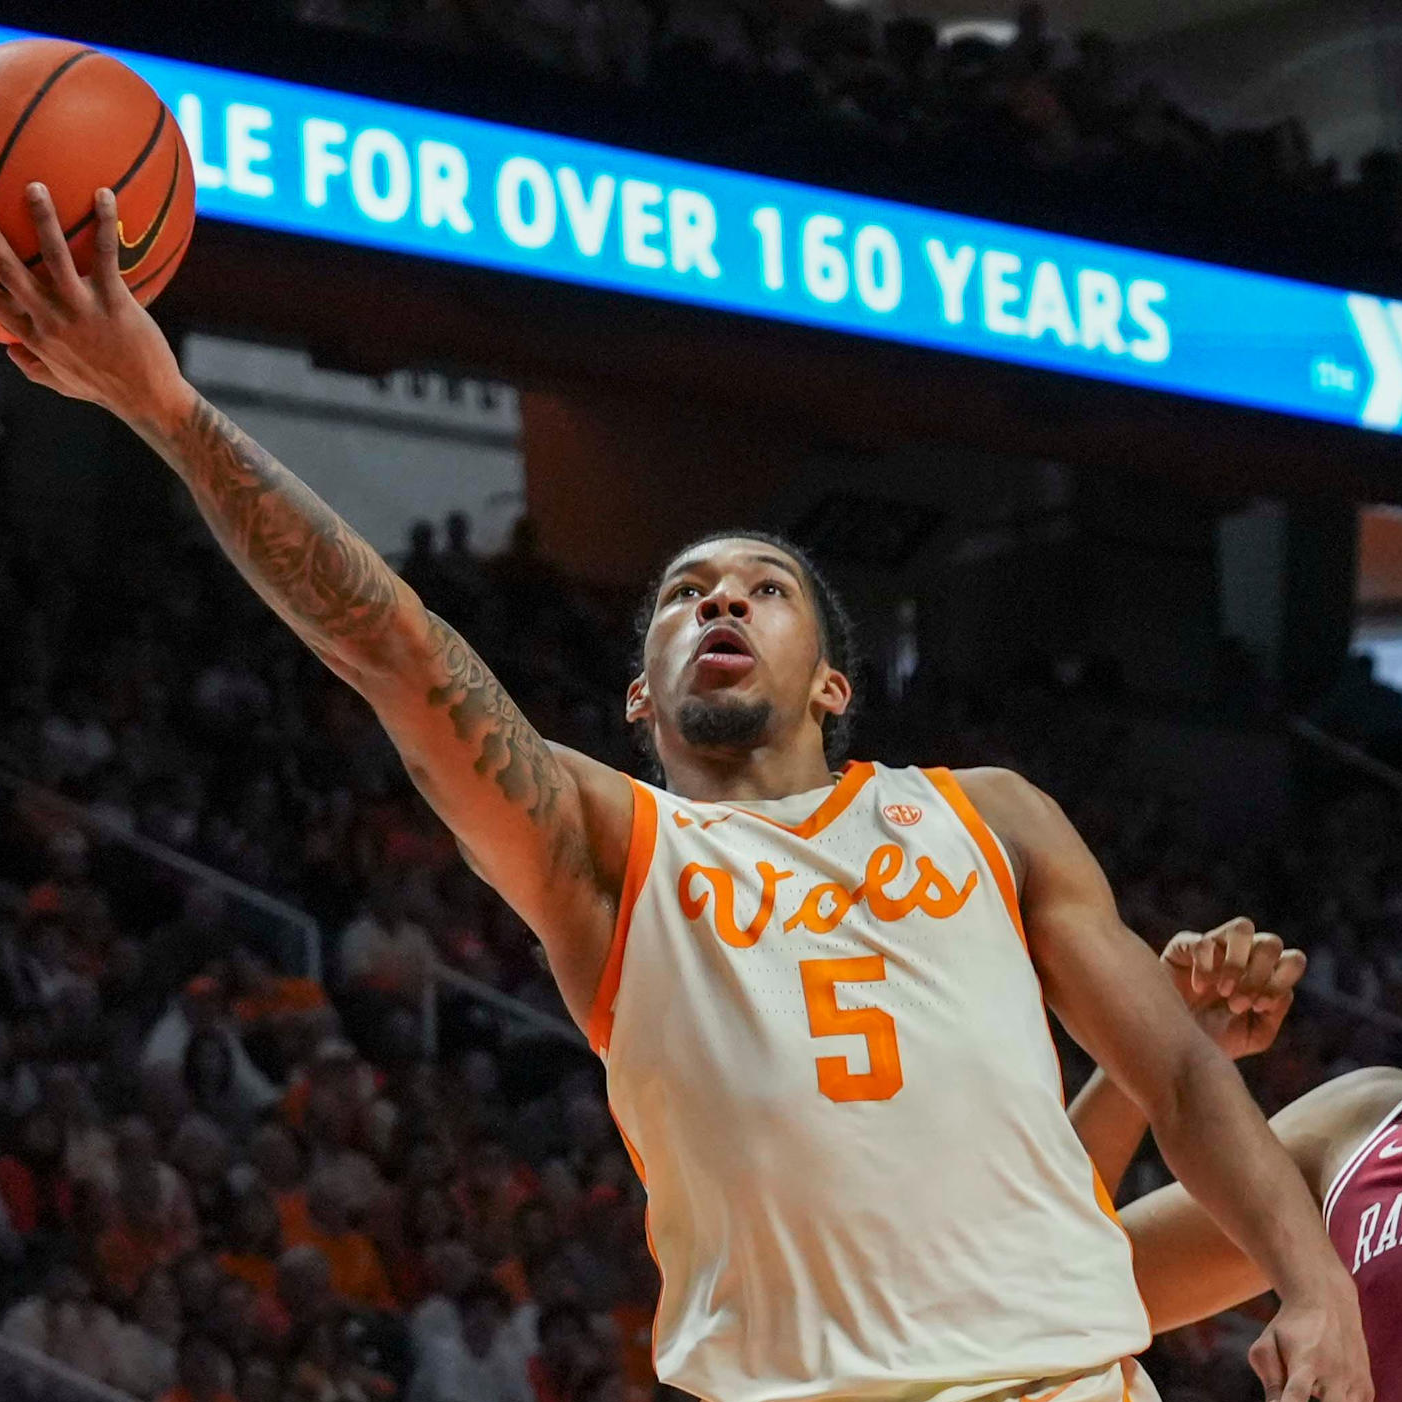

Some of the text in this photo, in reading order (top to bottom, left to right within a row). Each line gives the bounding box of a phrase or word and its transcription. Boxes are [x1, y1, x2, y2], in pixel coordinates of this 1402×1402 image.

[302, 117, 474, 235] FOR
[496, 156, 721, 279] OVER
[752, 206, 903, 312] 160
[925, 238, 1171, 363] YEARS
[678, 844, 978, 948] Vols
[799, 955, 904, 1104] 5
